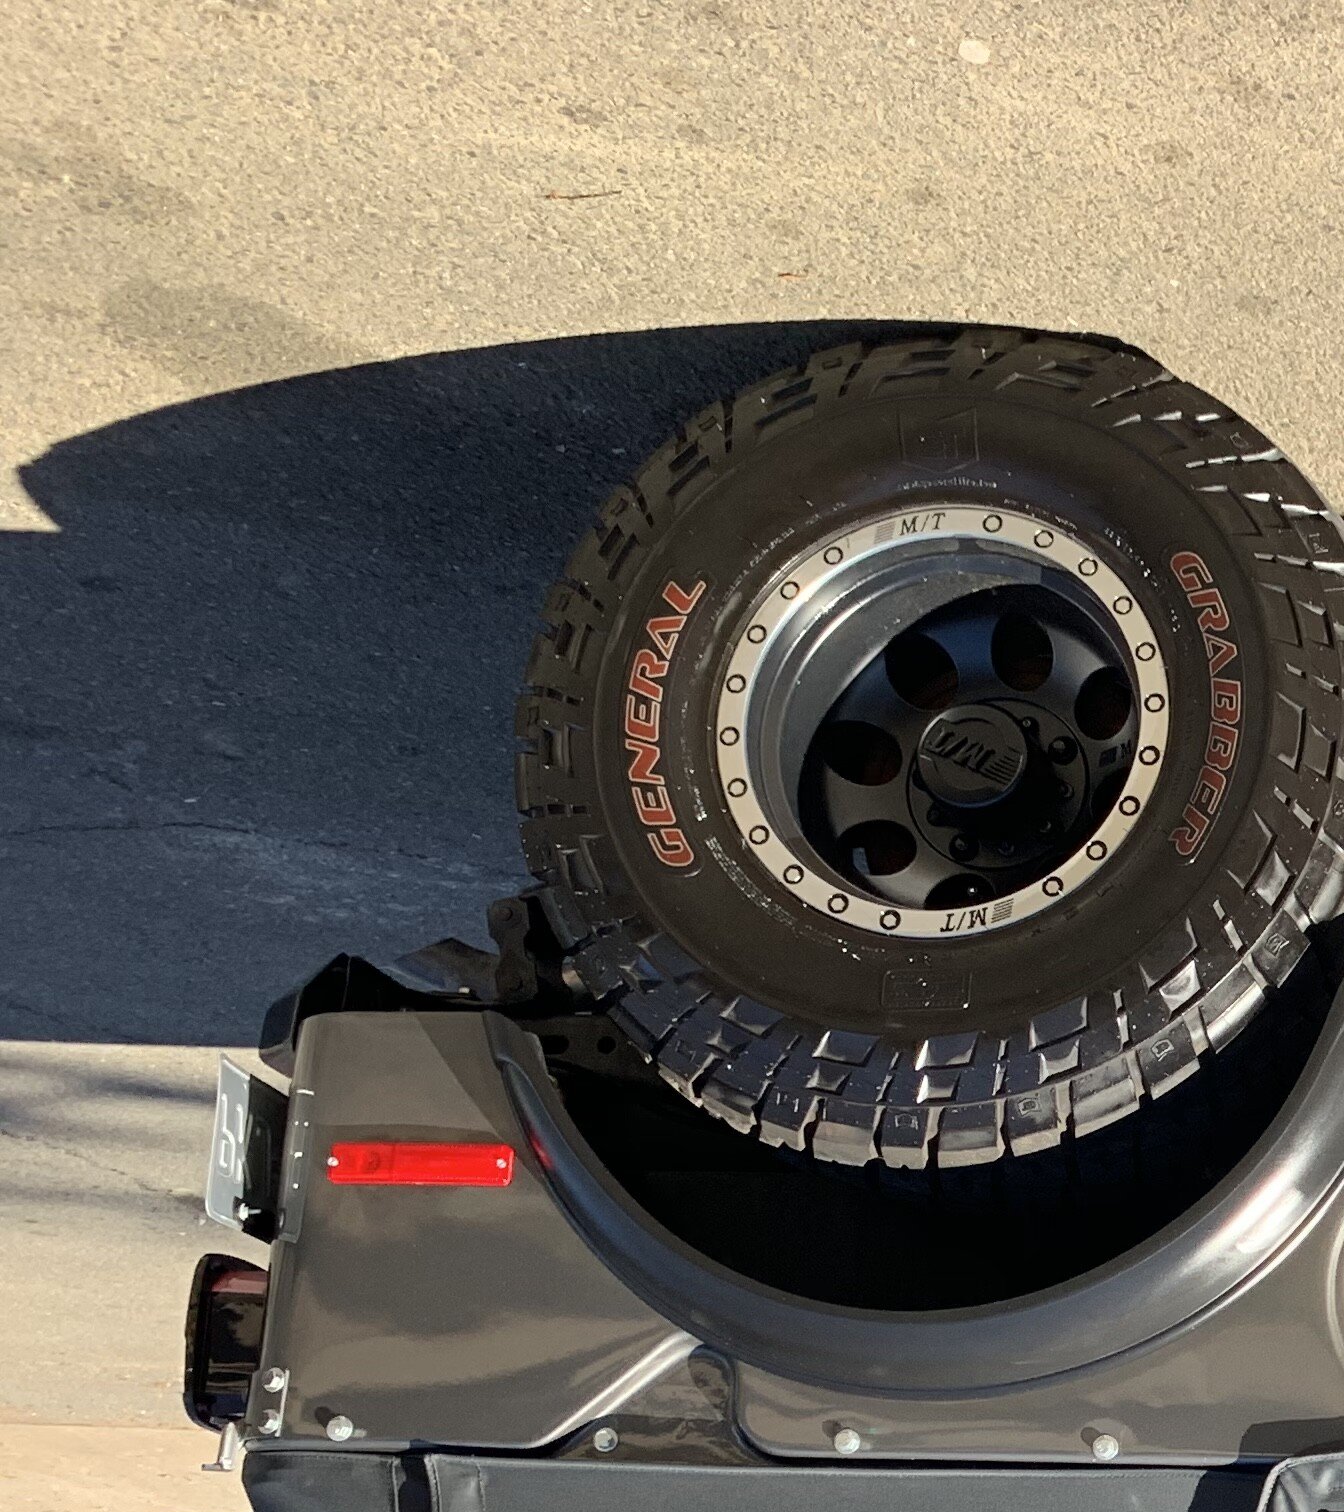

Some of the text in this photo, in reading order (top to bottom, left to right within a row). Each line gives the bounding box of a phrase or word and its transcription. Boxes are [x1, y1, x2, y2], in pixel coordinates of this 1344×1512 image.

[898, 511, 947, 537] M/T
[624, 576, 706, 868] GENERAL
[1166, 549, 1244, 859] GRABBER
[924, 730, 996, 772] M/T
[939, 907, 989, 932] M/T
